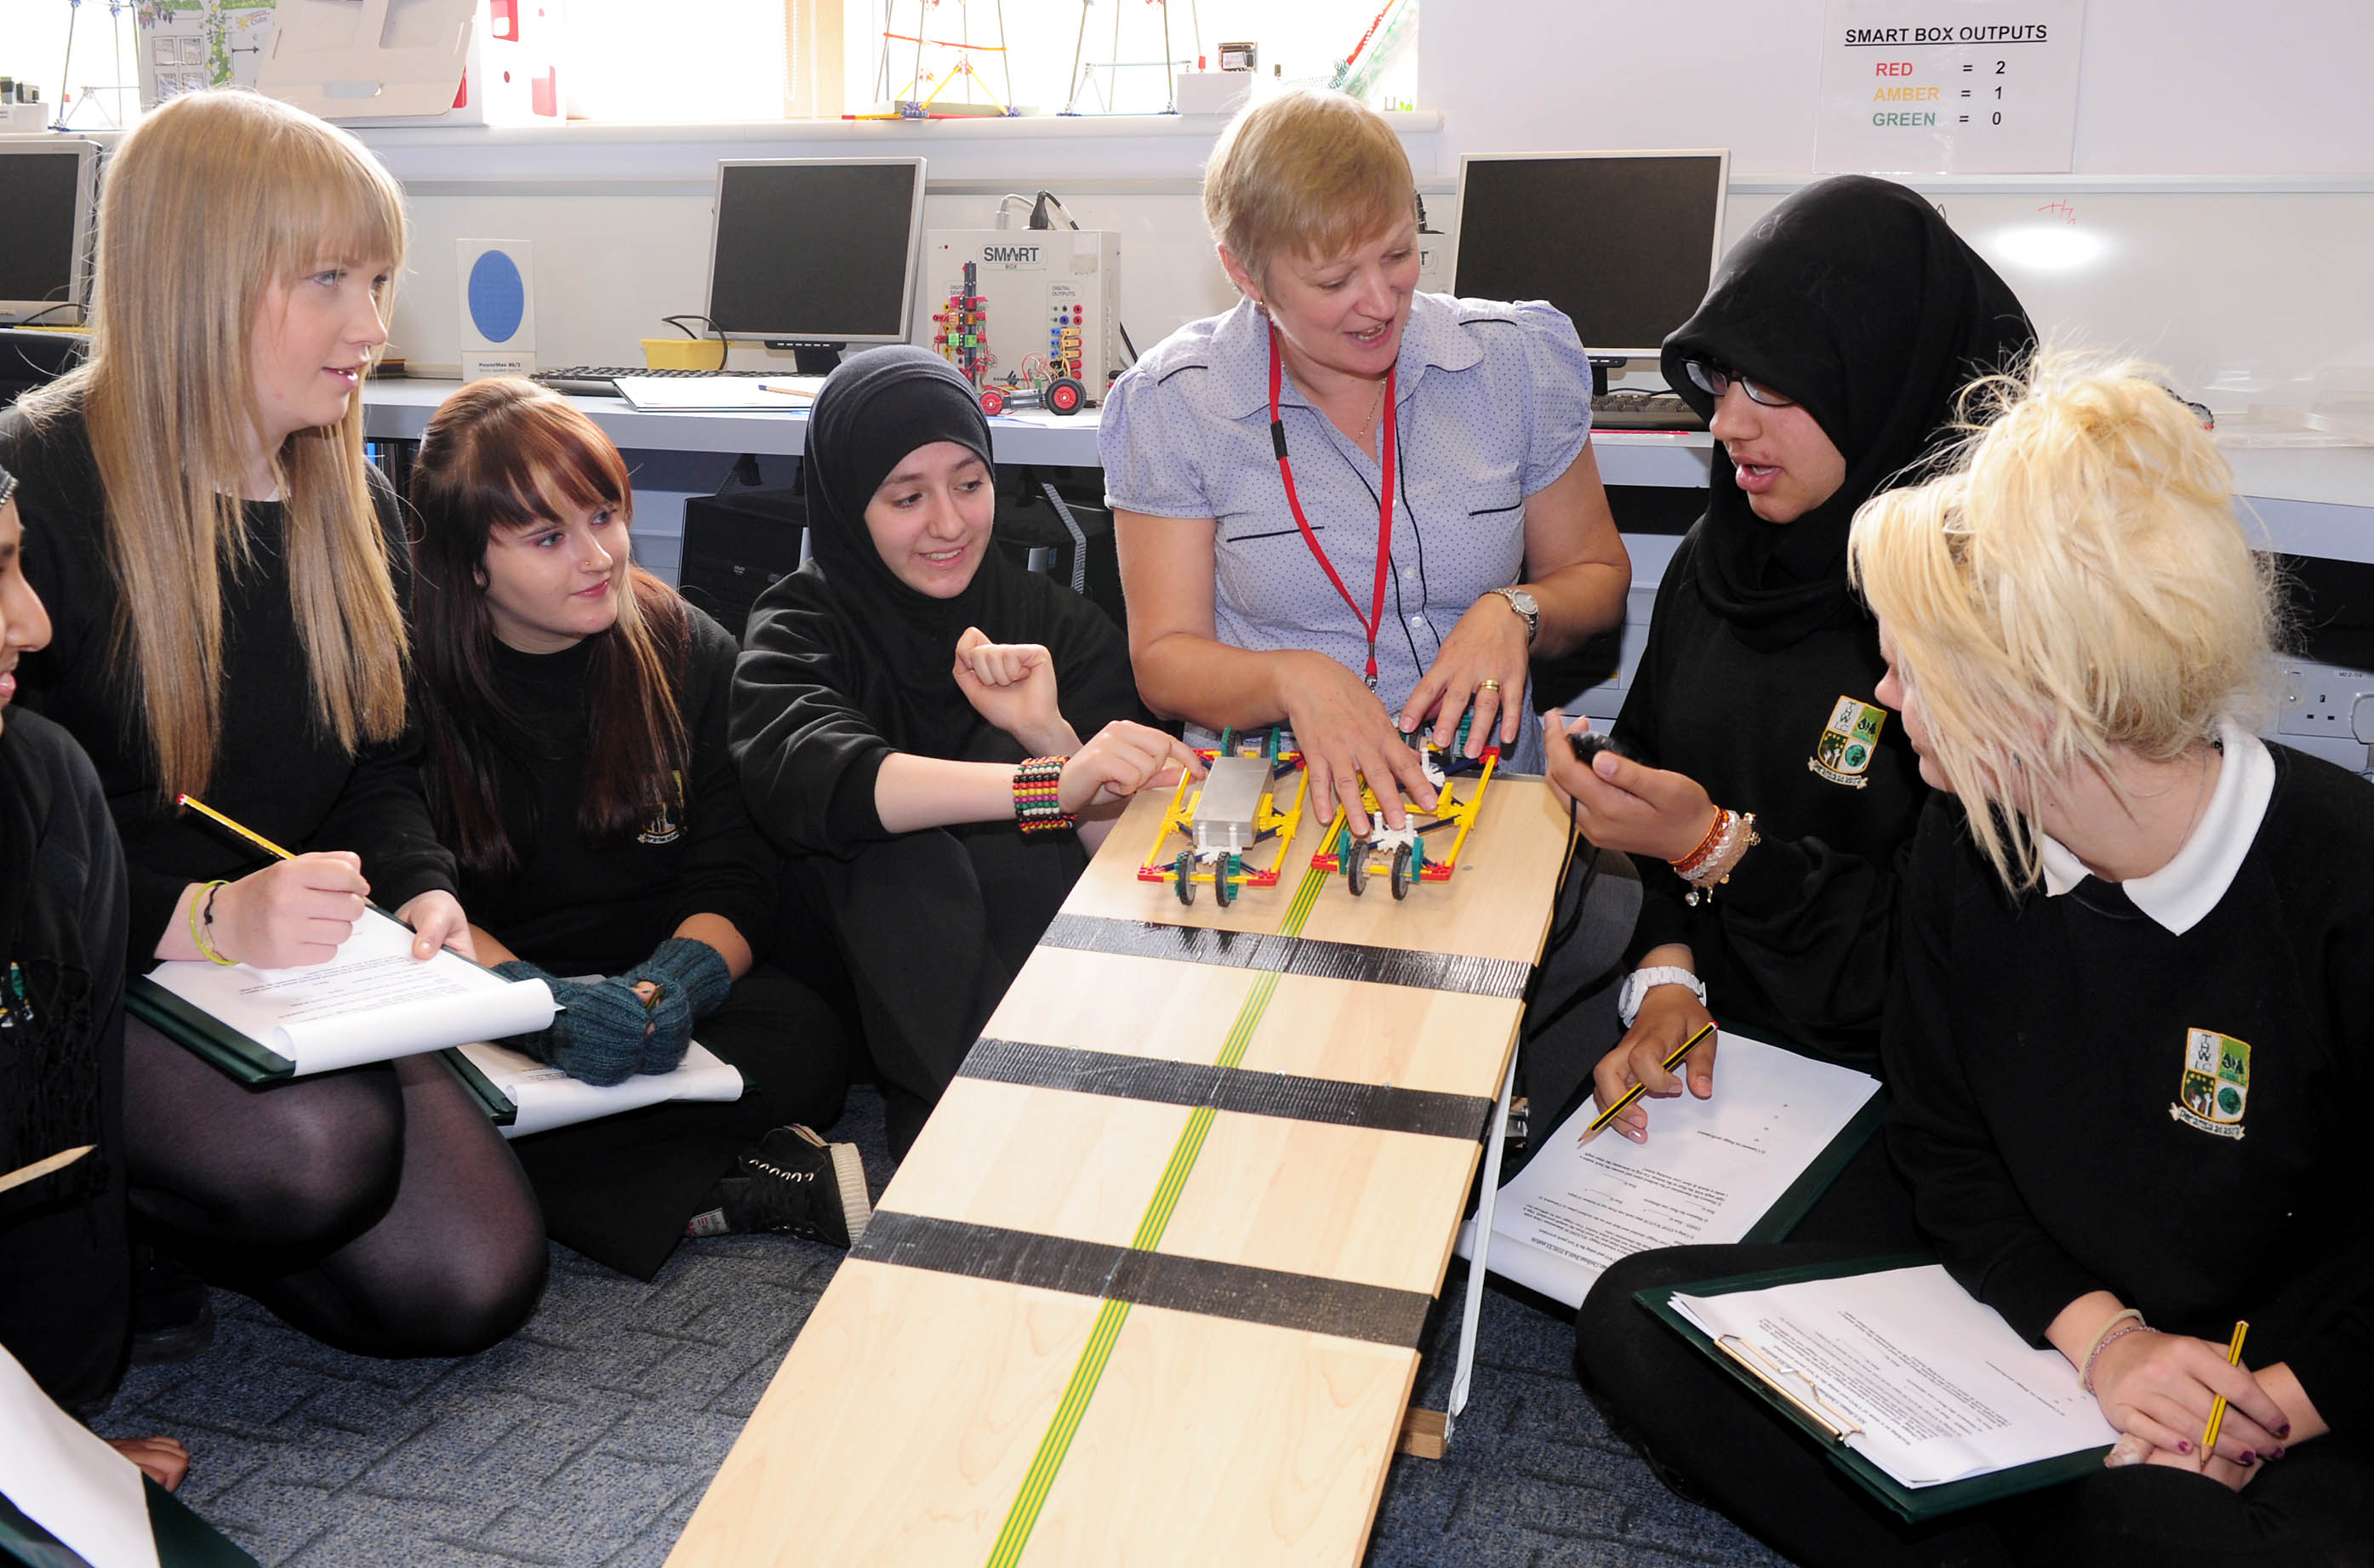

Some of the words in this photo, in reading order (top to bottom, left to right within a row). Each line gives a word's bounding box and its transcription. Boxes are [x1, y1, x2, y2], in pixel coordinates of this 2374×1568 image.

[1845, 28, 1909, 43] SMART
[1915, 27, 1955, 42] BOX
[1959, 25, 2048, 41] OUTPUTS
[1875, 62, 1914, 77] RED
[1995, 60, 2006, 75] 2
[1873, 87, 1941, 102] AMBER
[1995, 86, 2003, 100] 1
[1872, 111, 1937, 127] GREEN
[1991, 111, 2002, 126] 0
[983, 247, 1040, 262] SMART
